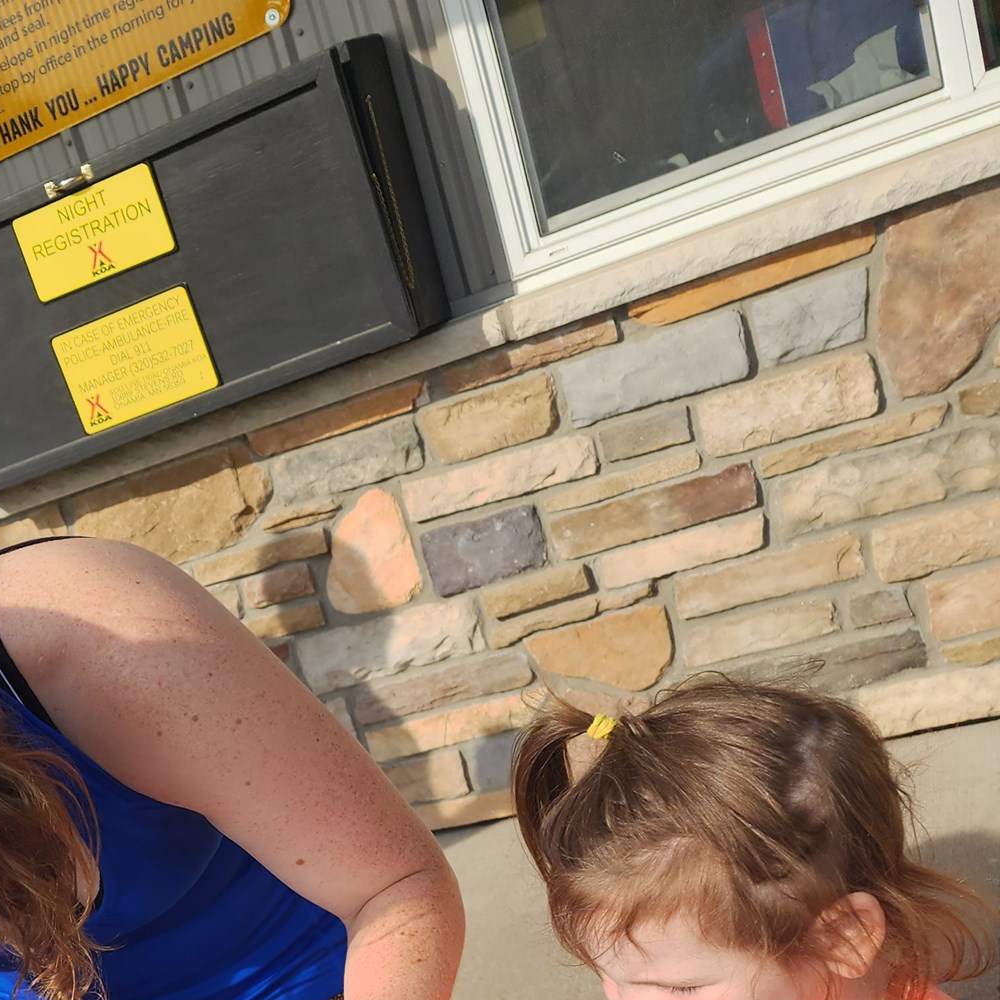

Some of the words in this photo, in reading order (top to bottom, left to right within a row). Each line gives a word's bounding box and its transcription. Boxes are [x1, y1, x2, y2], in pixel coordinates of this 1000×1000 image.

[20, 69, 37, 85] by
[39, 51, 73, 76] office
[74, 44, 87, 58] in
[87, 33, 109, 54] the
[110, 5, 165, 39] morning
[22, 13, 50, 37] seal.
[34, 40, 48, 53] in
[49, 21, 82, 47] night
[83, 8, 111, 29] time
[45, 88, 80, 120] YOU
[96, 53, 150, 97] HAPPY
[157, 12, 236, 67] CAMPING
[31, 198, 151, 261] REGISTRATION
[56, 190, 106, 225] NIGHT
[92, 263, 116, 277] KOA
[60, 339, 73, 352] IN
[72, 328, 100, 347] CASE
[100, 321, 117, 336] OF
[117, 297, 180, 330] EMERGENCY
[64, 308, 189, 368] POLICE-AMBULANCE-FIRE
[78, 366, 128, 394] MANAGER
[129, 340, 194, 374] (320)532-7027
[108, 348, 132, 365] DIAL
[132, 340, 152, 356] 911
[90, 415, 113, 427] KOA
